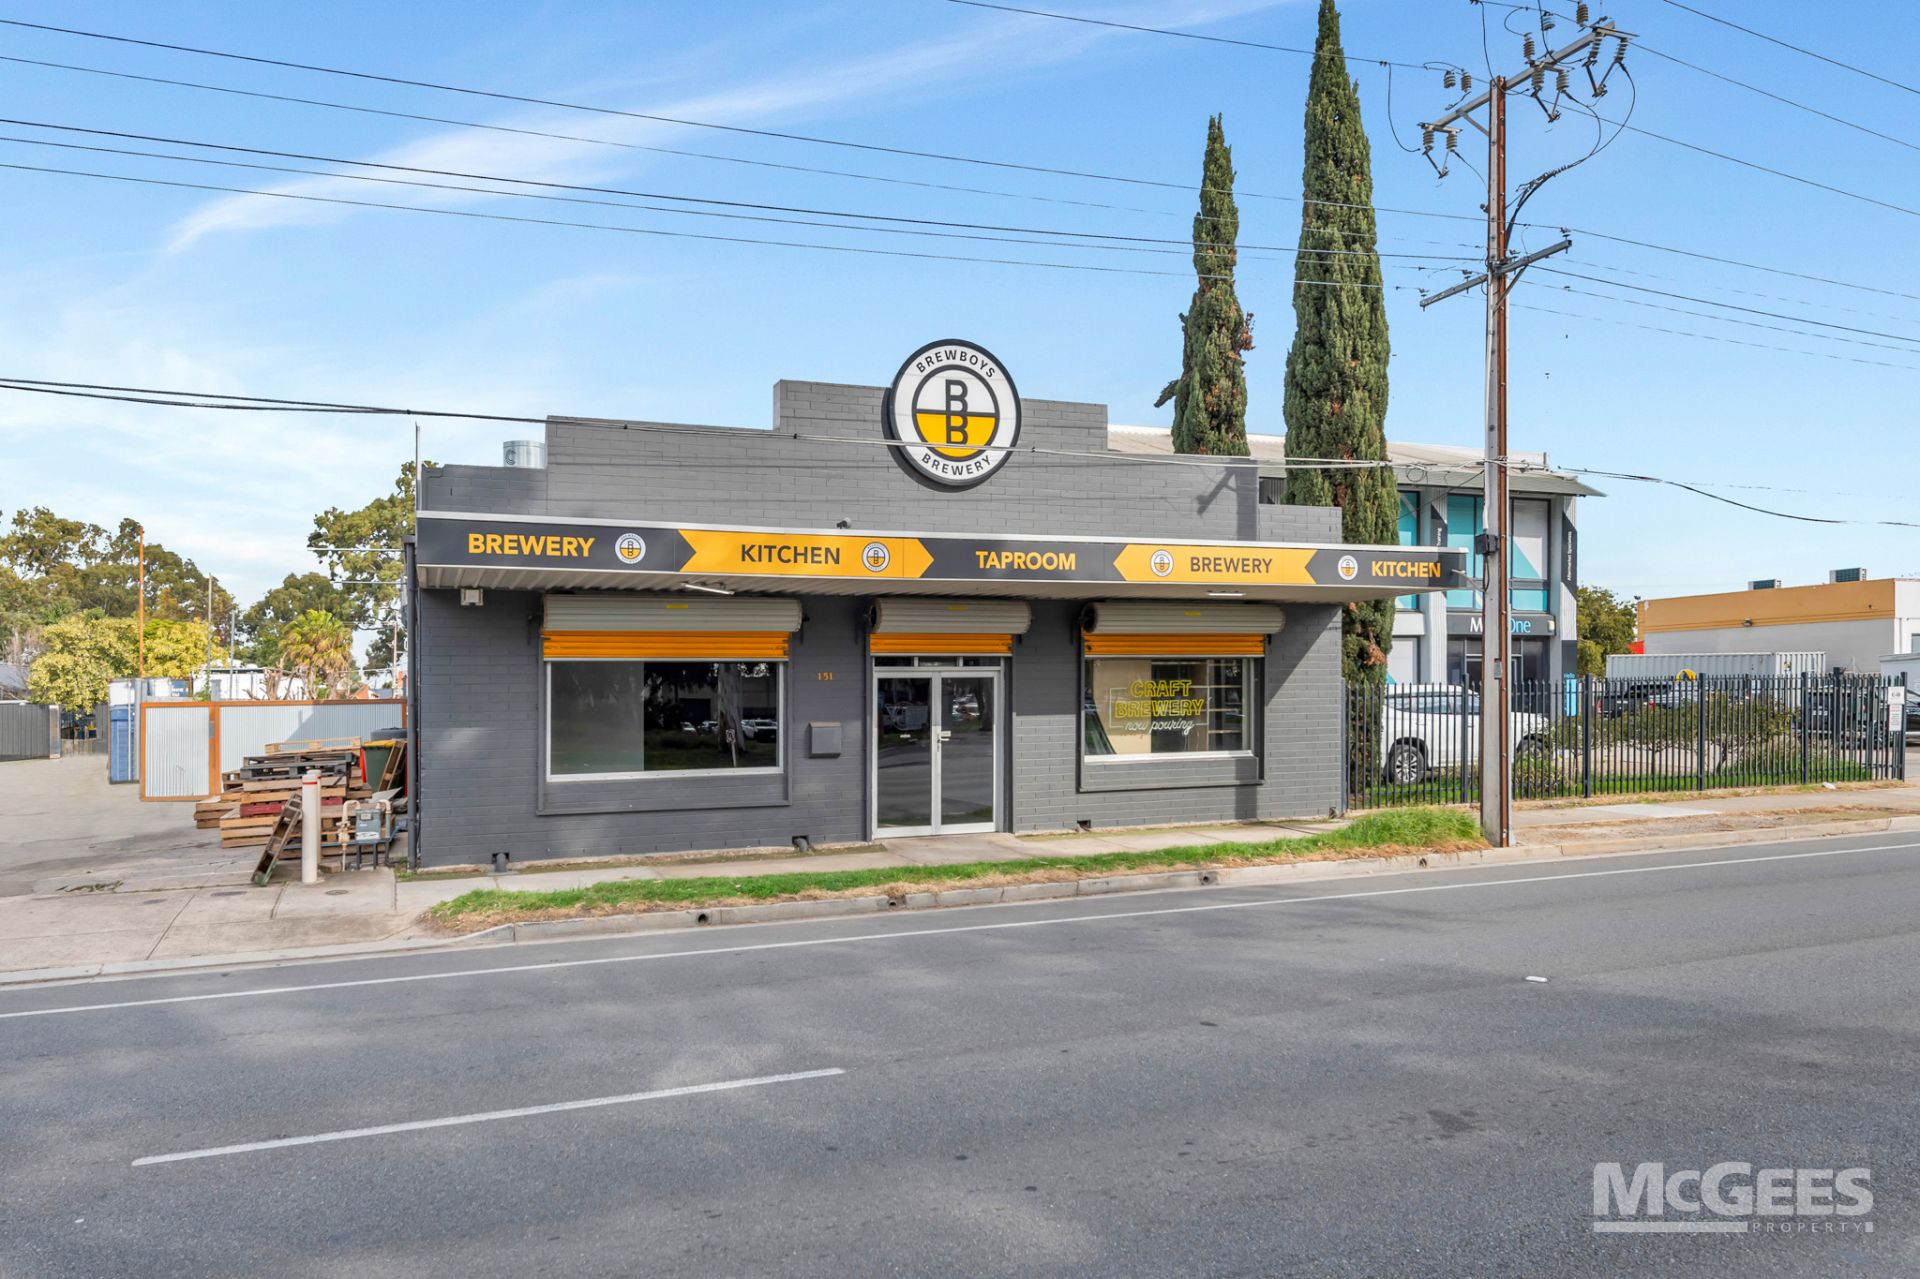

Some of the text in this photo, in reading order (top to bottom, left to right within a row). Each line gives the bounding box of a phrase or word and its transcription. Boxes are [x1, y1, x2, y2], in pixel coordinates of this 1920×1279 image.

[916, 350, 995, 378] BREWBOYS
[922, 453, 990, 476] BREWERY
[468, 533, 595, 558] BREWERY
[741, 544, 840, 565] KITCHEN
[976, 551, 1076, 571] TAPROOM
[1190, 557, 1273, 574] BREWERY
[1371, 560, 1440, 578] KITCHEN
[817, 671, 832, 681] 151
[1131, 680, 1192, 697] CRAFT
[1115, 700, 1204, 718] BREWERY
[1125, 718, 1195, 735] now pouring
